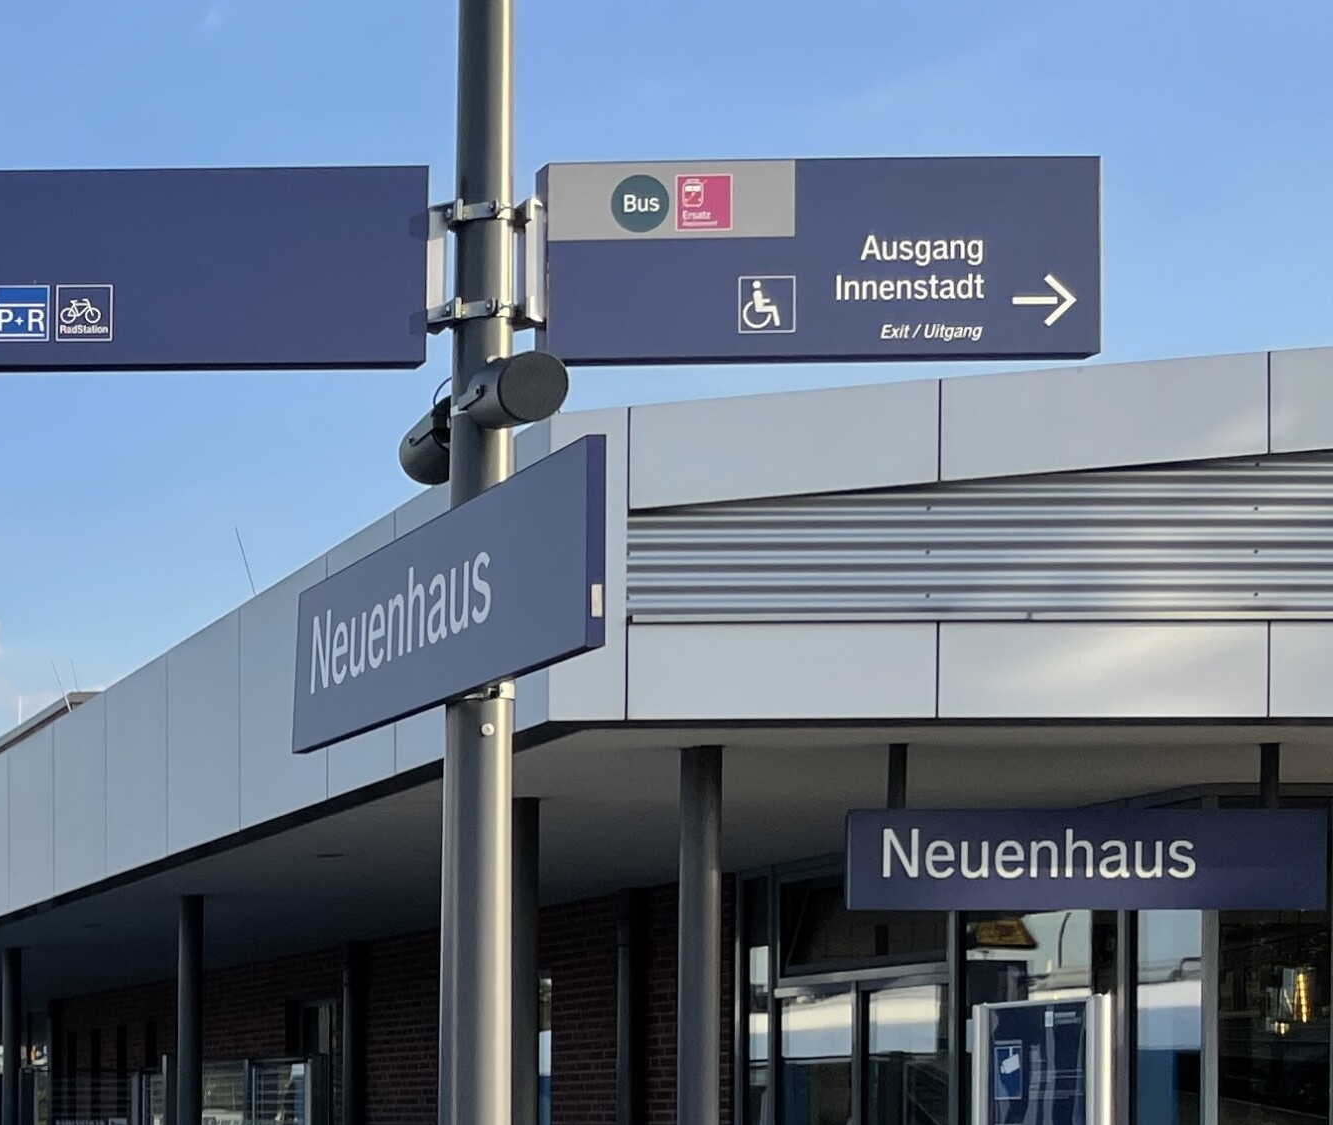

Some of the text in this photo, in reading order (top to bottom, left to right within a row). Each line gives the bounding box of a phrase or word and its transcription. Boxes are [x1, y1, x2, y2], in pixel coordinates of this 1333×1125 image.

[623, 194, 660, 213] Bus
[860, 234, 983, 267] Ausgang
[835, 273, 985, 300] Innenstadt
[59, 324, 109, 334] RadStation
[880, 324, 910, 340] Exit
[924, 324, 983, 342] Uitgang
[309, 551, 492, 695] Neuenhaus
[882, 828, 1197, 879] Neuenhaus
